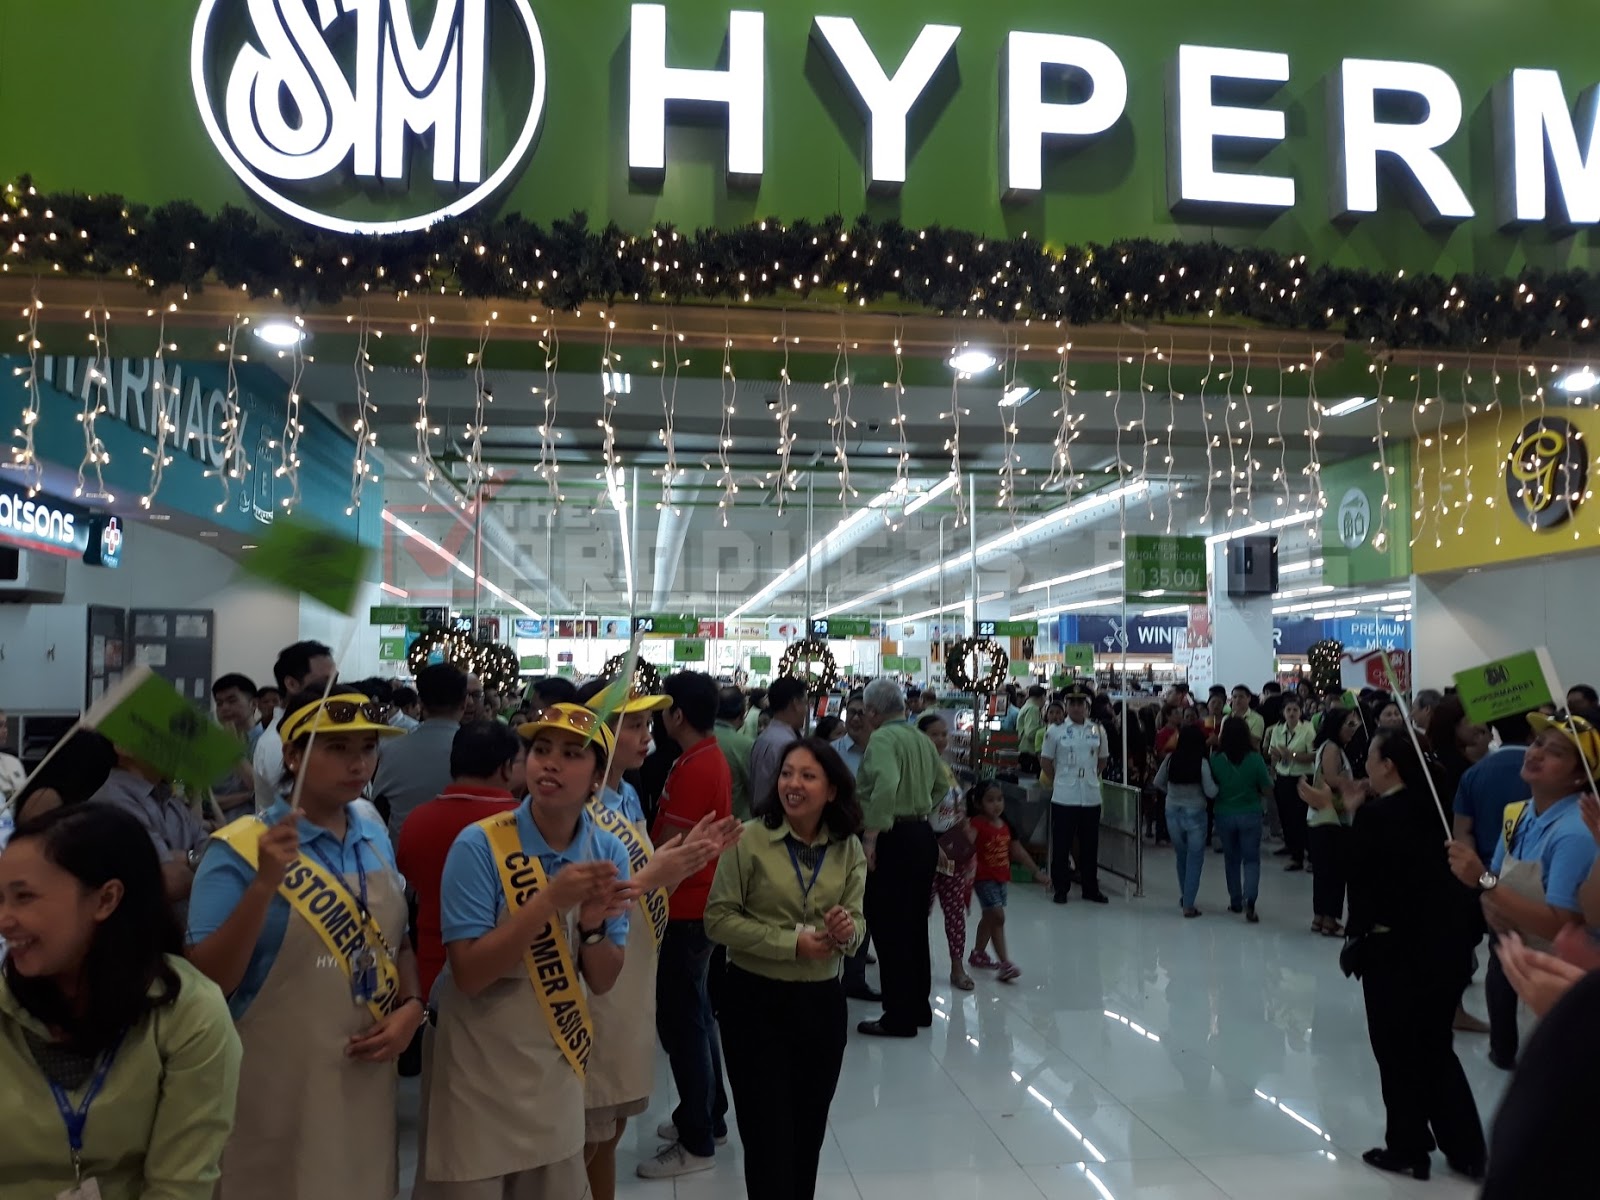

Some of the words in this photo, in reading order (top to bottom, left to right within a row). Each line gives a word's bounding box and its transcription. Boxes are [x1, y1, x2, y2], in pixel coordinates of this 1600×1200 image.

[44, 355, 248, 477] ARMACY
[456, 618, 472, 632] 26
[637, 618, 653, 633] 24
[814, 620, 828, 634] 23
[980, 622, 995, 635] 22
[1351, 623, 1405, 637] PREMIUM
[1137, 626, 1173, 644] WIN
[592, 800, 648, 872] USTOME
[284, 858, 368, 960] STOMER
[505, 851, 569, 997] CUSOMER
